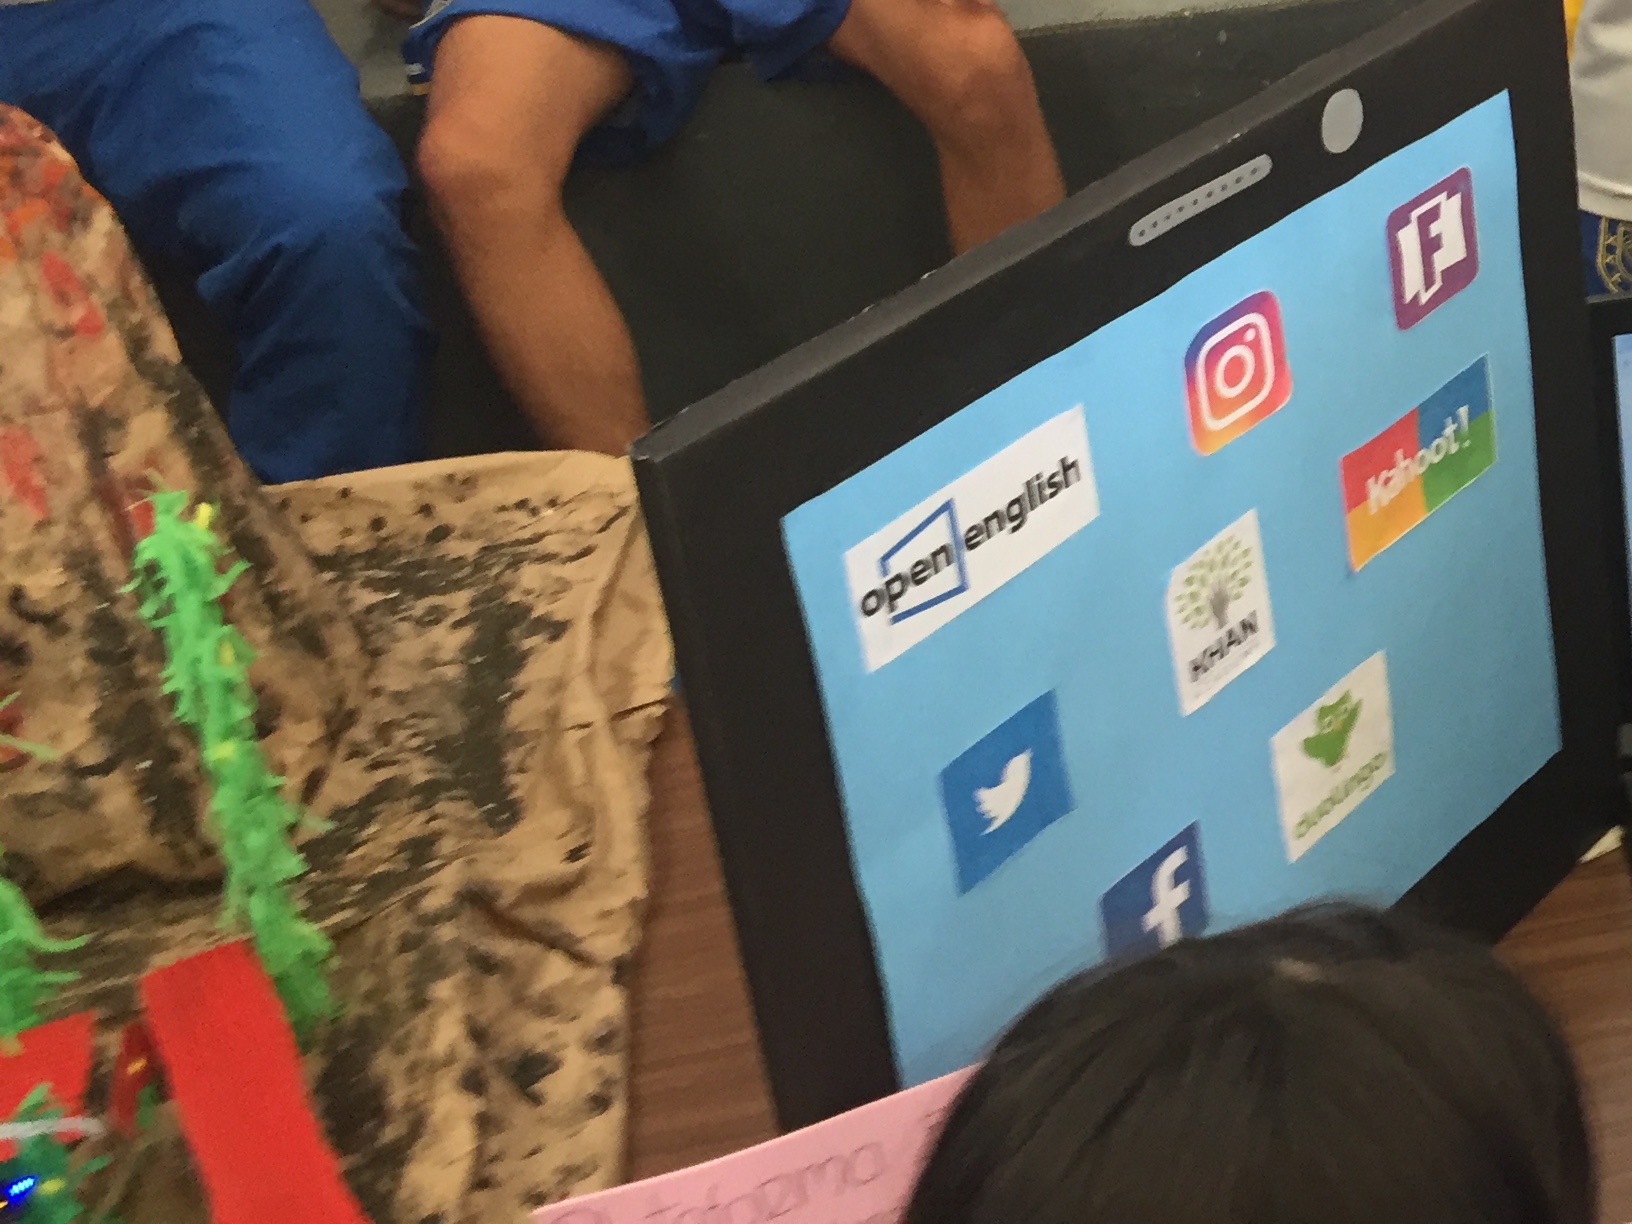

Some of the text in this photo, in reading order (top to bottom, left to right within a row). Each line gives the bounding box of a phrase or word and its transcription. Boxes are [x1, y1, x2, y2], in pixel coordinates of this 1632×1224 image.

[860, 455, 1082, 618] open english
[1188, 609, 1259, 683] KHAN
